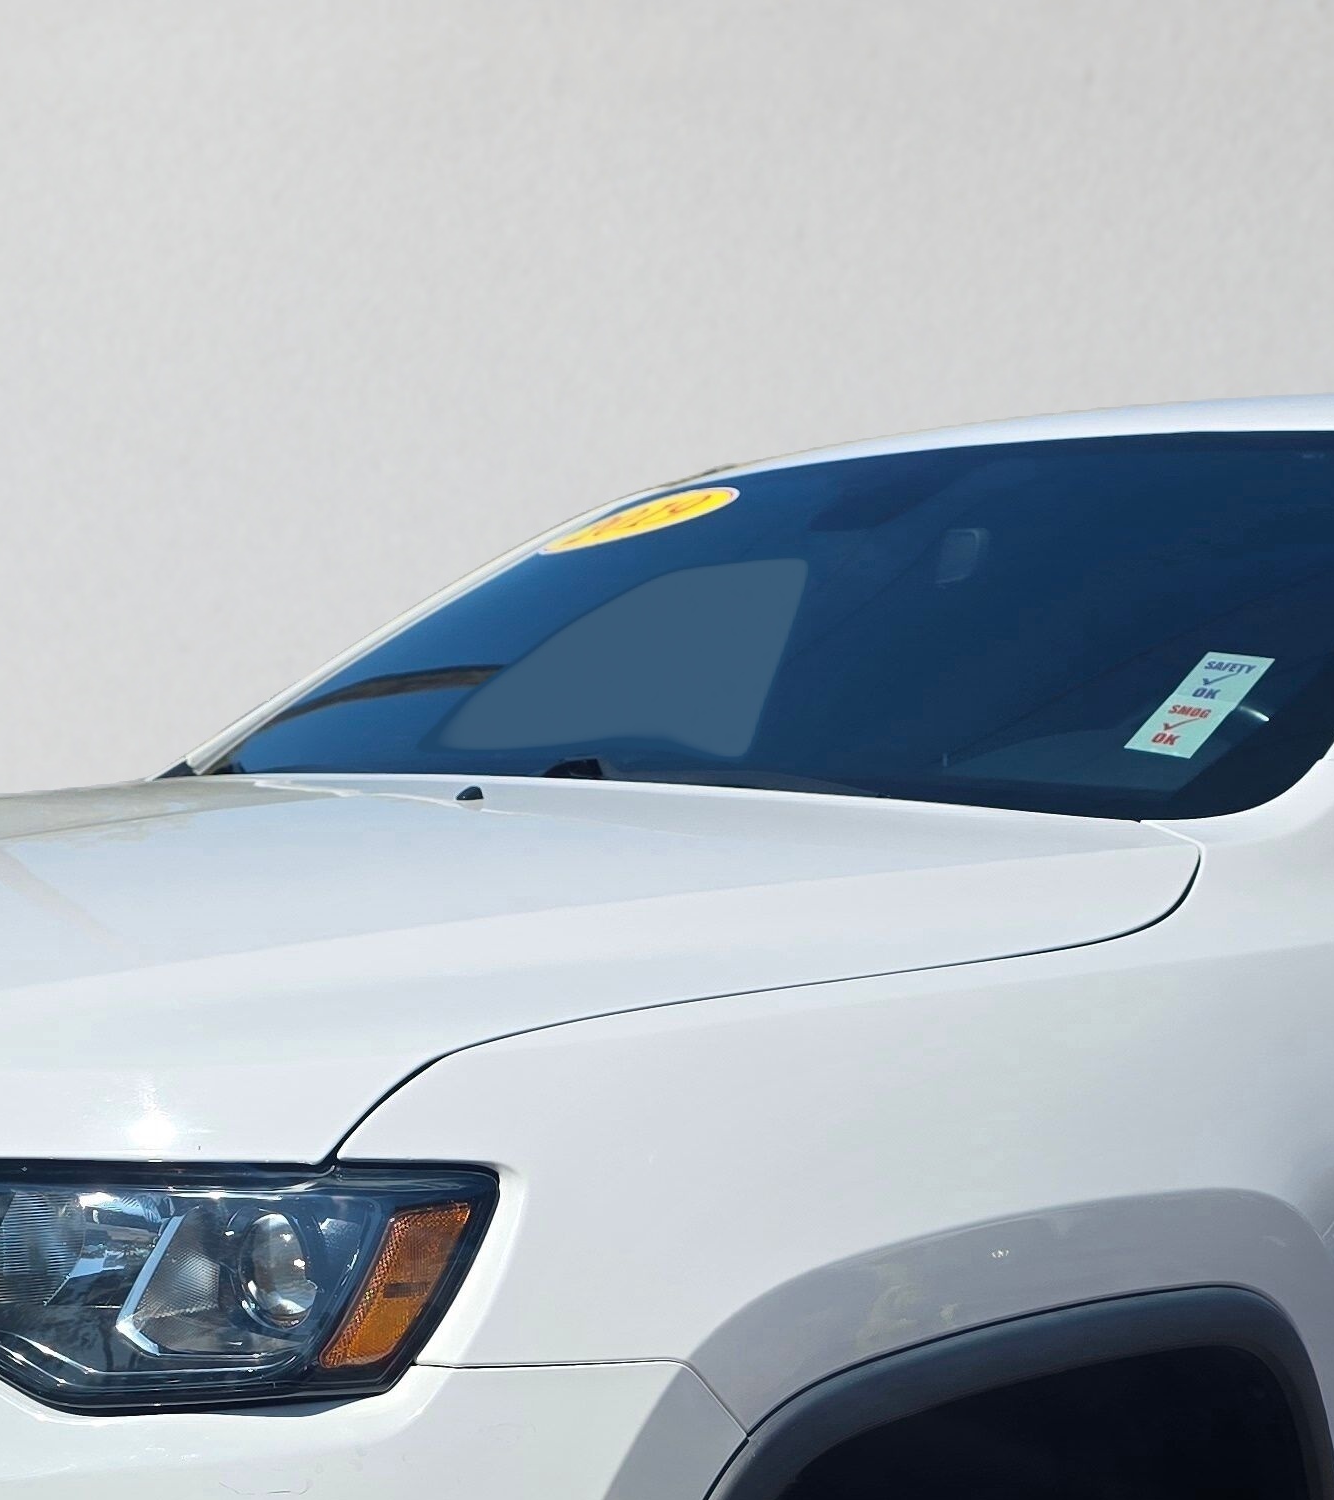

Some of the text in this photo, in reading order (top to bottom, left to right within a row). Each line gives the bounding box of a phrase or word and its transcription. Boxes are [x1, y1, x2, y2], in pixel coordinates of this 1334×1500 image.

[1203, 660, 1257, 675] SAFETY
[1192, 687, 1221, 700] OK
[1168, 704, 1212, 719] SMOG
[1151, 732, 1180, 746] OK
